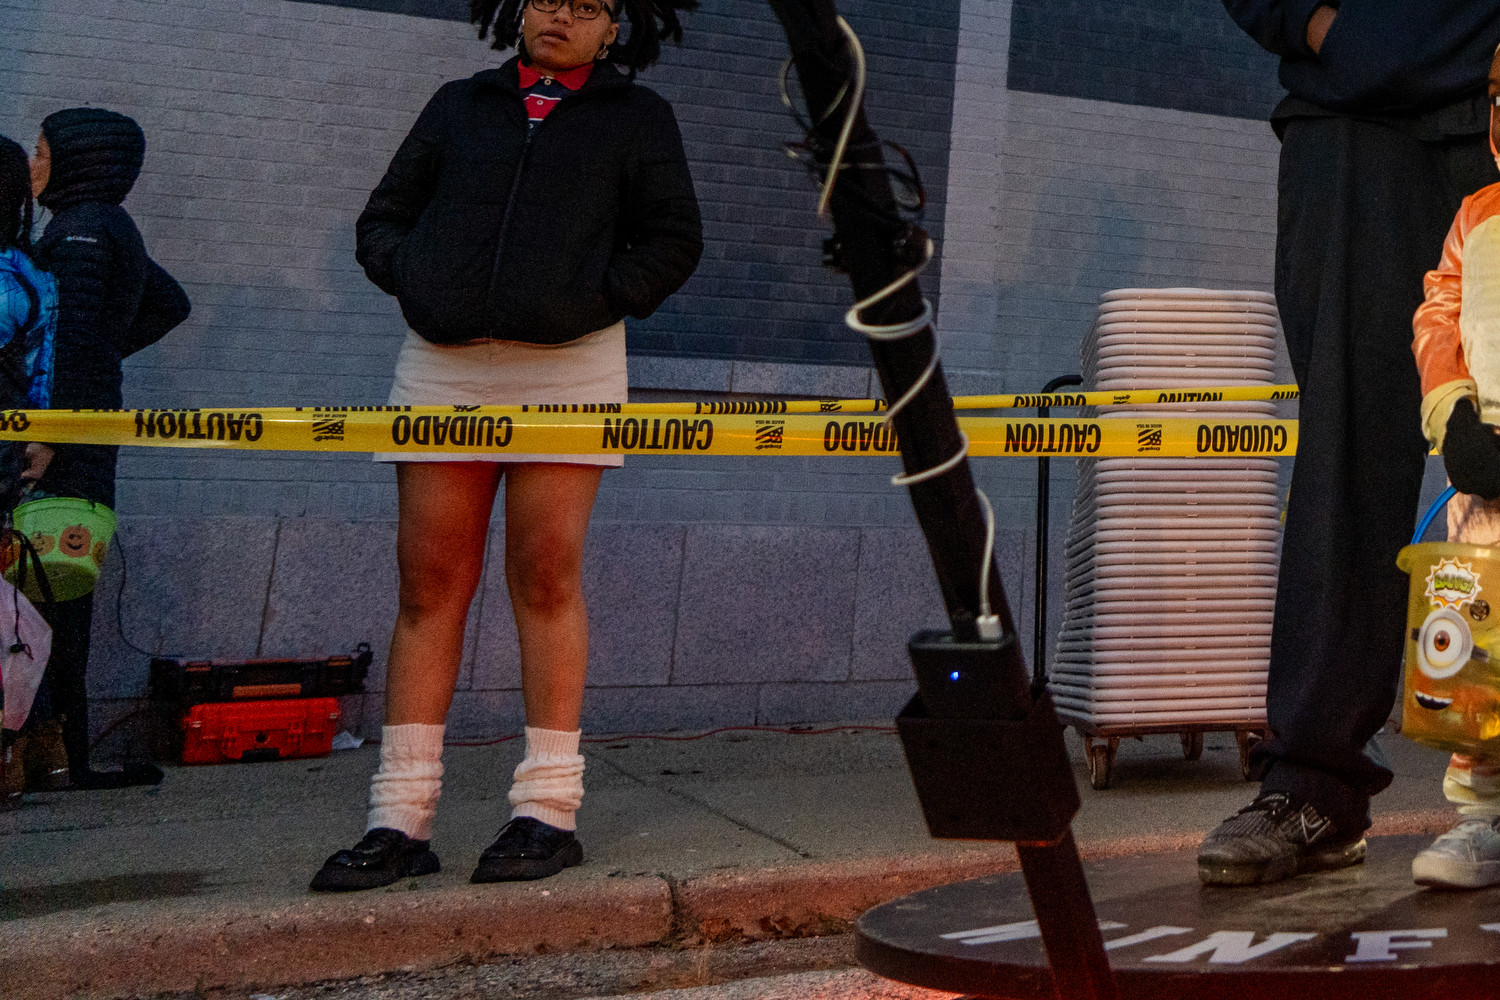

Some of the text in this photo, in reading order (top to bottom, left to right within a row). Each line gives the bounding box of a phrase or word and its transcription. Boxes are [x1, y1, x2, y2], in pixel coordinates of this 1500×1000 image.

[134, 412, 263, 442] CAUTION
[392, 415, 513, 447] CUIDADO
[602, 418, 714, 450] CAUTION
[1005, 423, 1102, 453] CAUTION
[1196, 424, 1288, 454] CUIDADO
